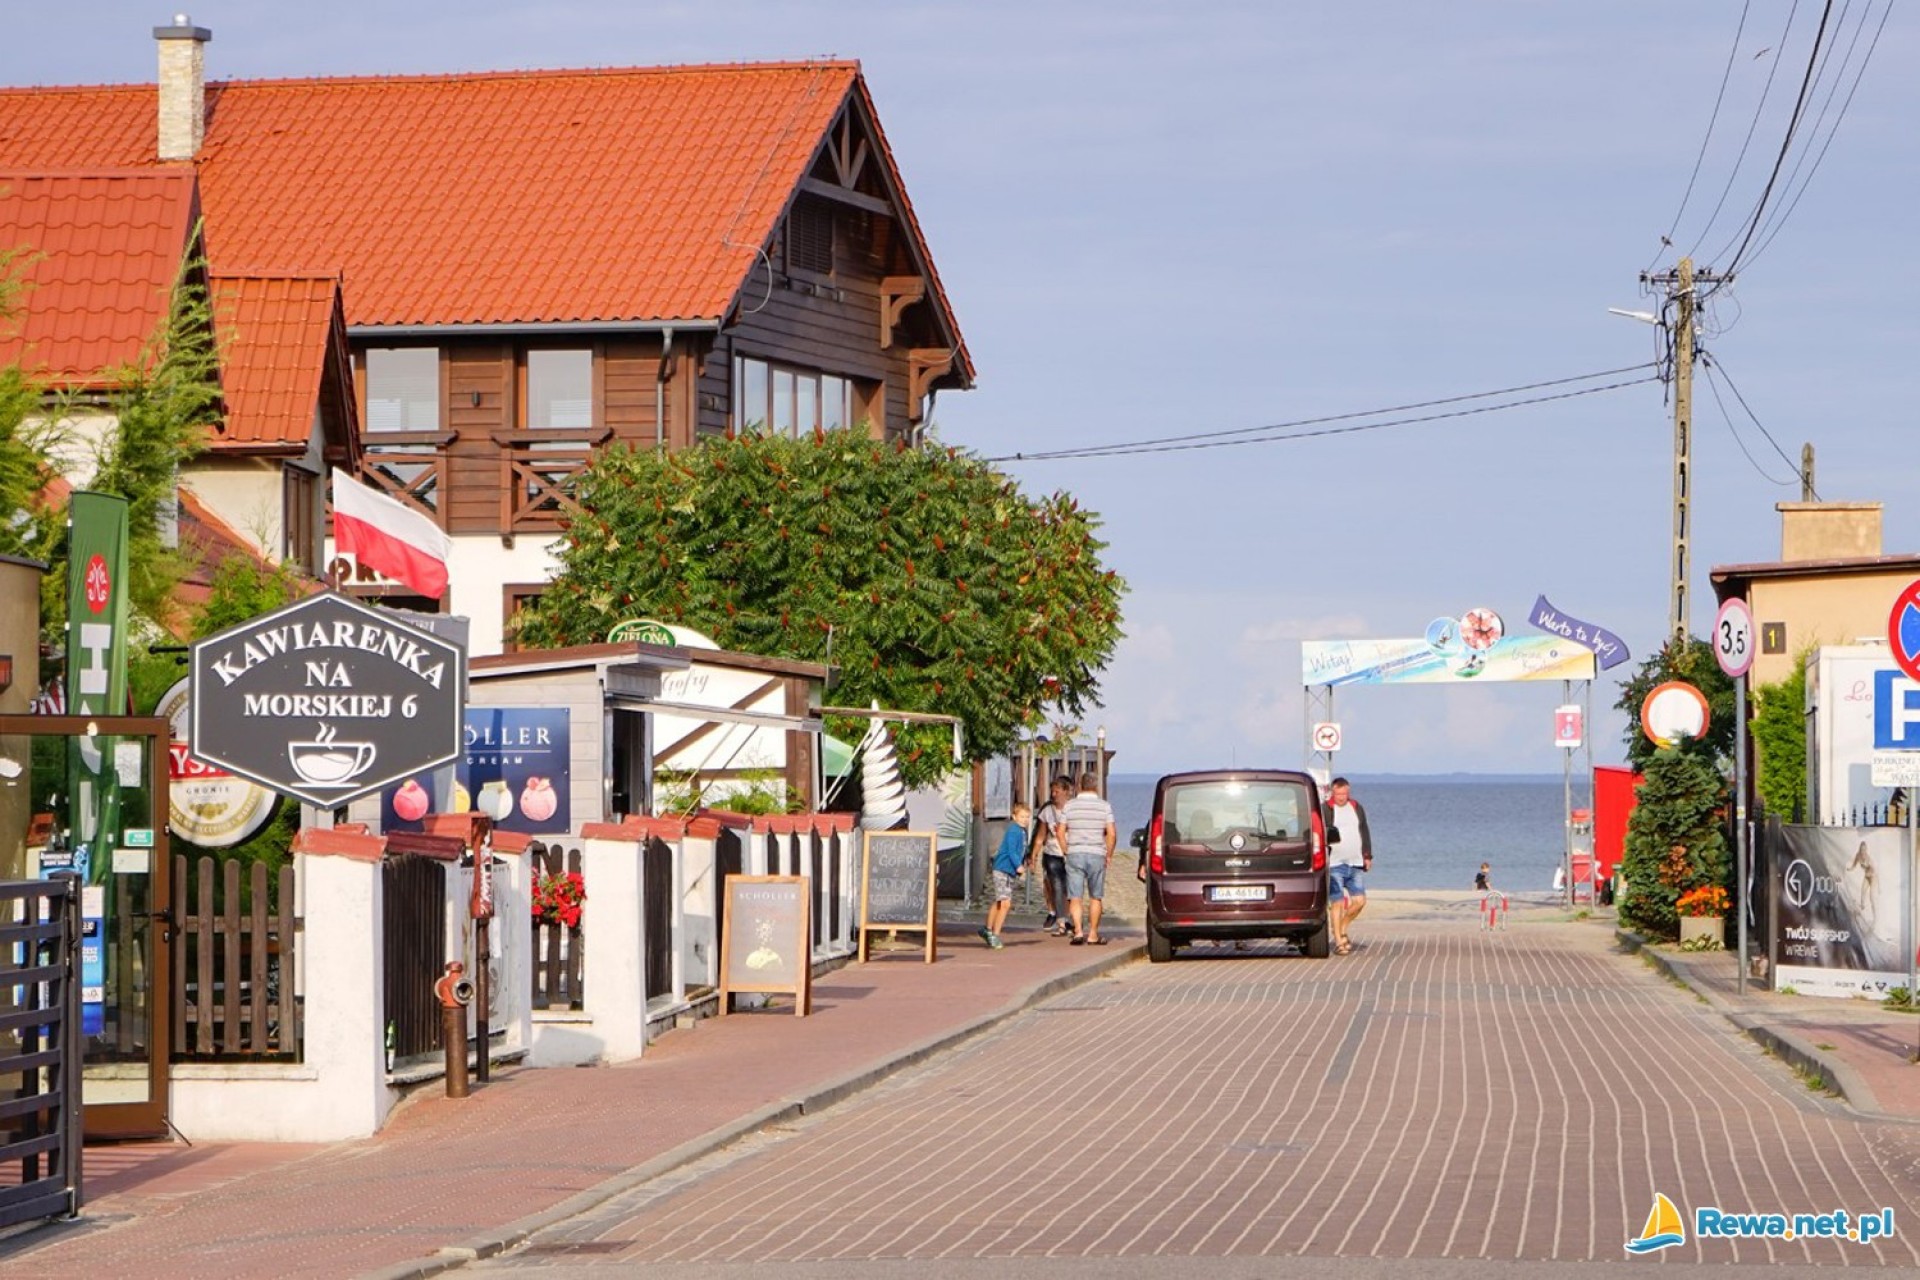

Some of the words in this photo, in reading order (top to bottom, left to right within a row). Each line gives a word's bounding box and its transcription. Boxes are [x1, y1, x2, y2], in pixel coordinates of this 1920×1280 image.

[1539, 611, 1573, 636] Warto
[1576, 626, 1588, 641] tu
[1768, 628, 1776, 649] 1
[210, 620, 445, 690] KAWIARENKA
[305, 661, 352, 687] NA
[243, 694, 394, 718] MORSKIEJ
[401, 694, 418, 718] 6
[464, 725, 551, 746] ÖLLER
[467, 757, 523, 765] CREAM
[1815, 876, 1834, 894] 100
[1785, 925, 1810, 940] TWÓJ
